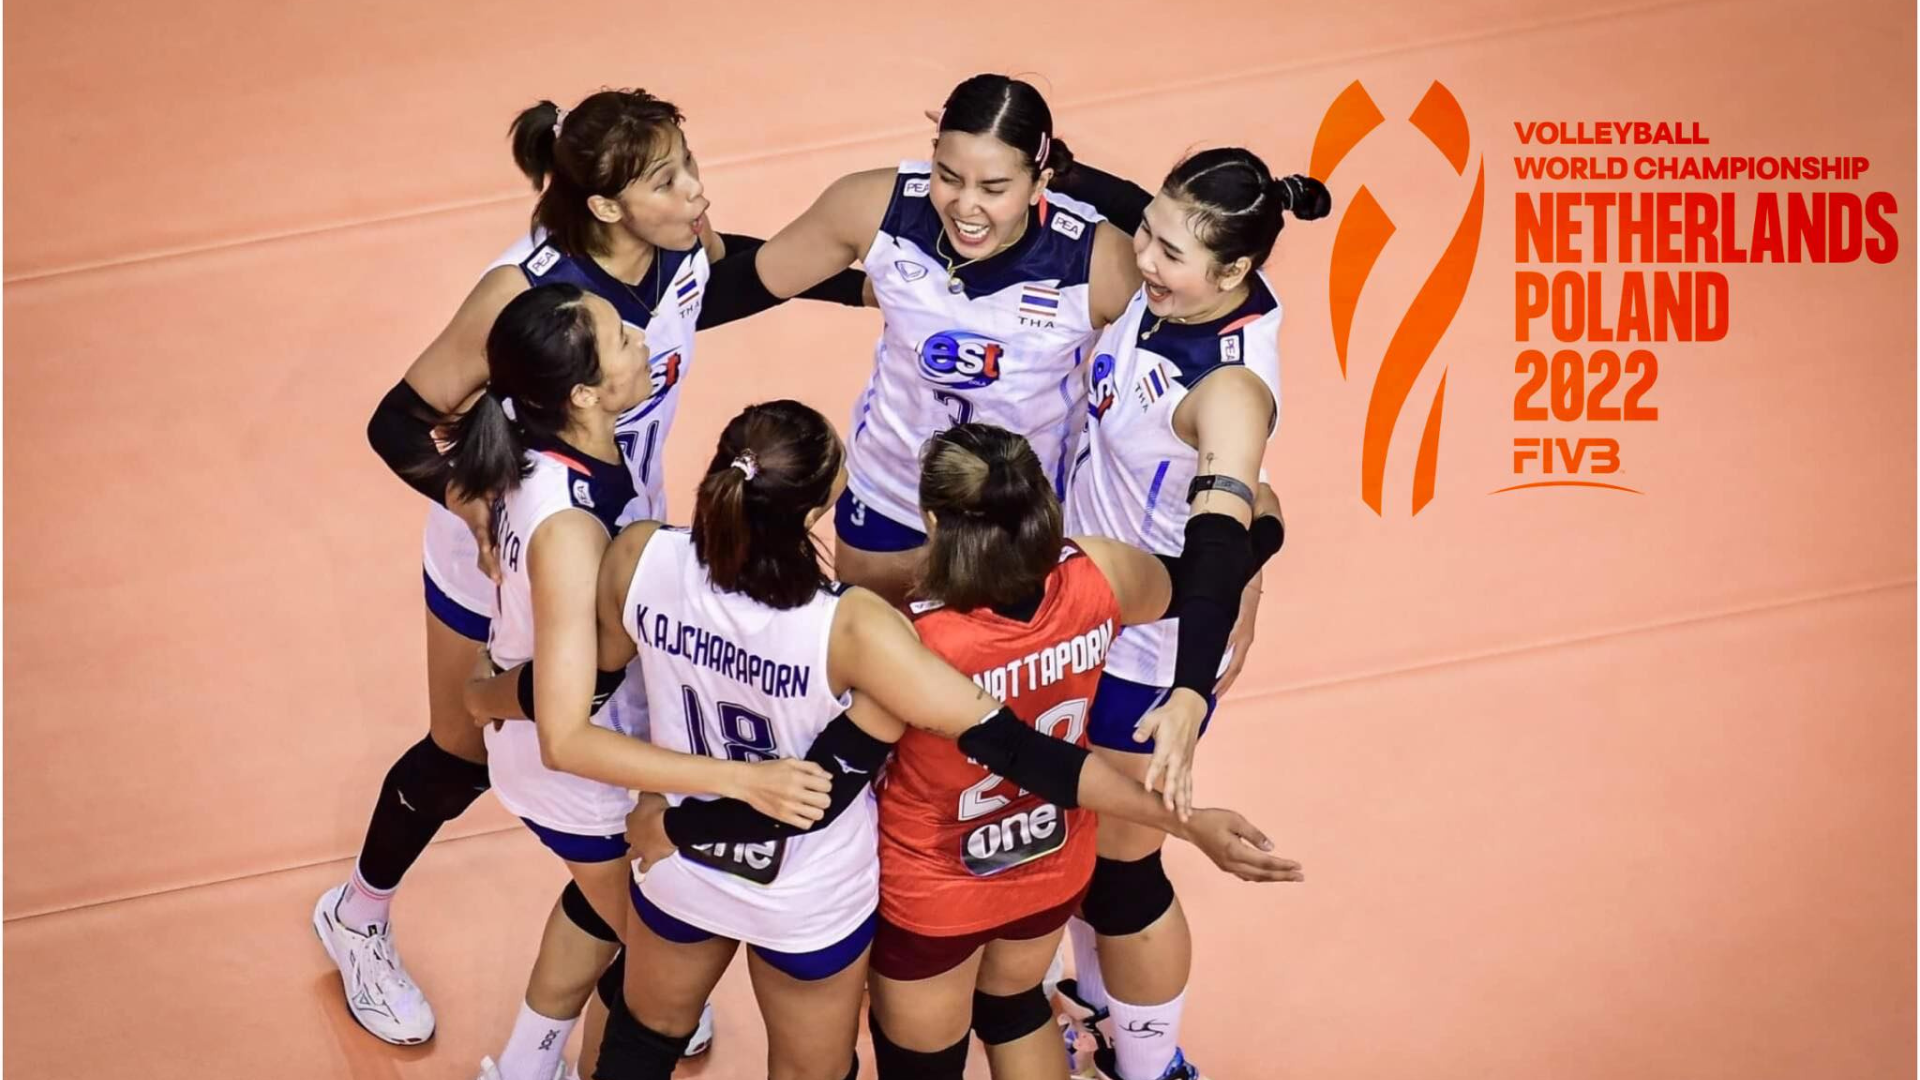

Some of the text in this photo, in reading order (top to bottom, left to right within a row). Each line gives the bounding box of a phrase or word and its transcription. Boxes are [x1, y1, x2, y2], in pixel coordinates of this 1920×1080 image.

[906, 182, 930, 194] PEA
[1054, 215, 1079, 237] PEA
[531, 249, 557, 273] PEA
[1018, 316, 1055, 329] THA
[922, 333, 1004, 381] est
[1224, 338, 1236, 361] PEA
[681, 684, 780, 763] 18
[966, 803, 1058, 860] one
